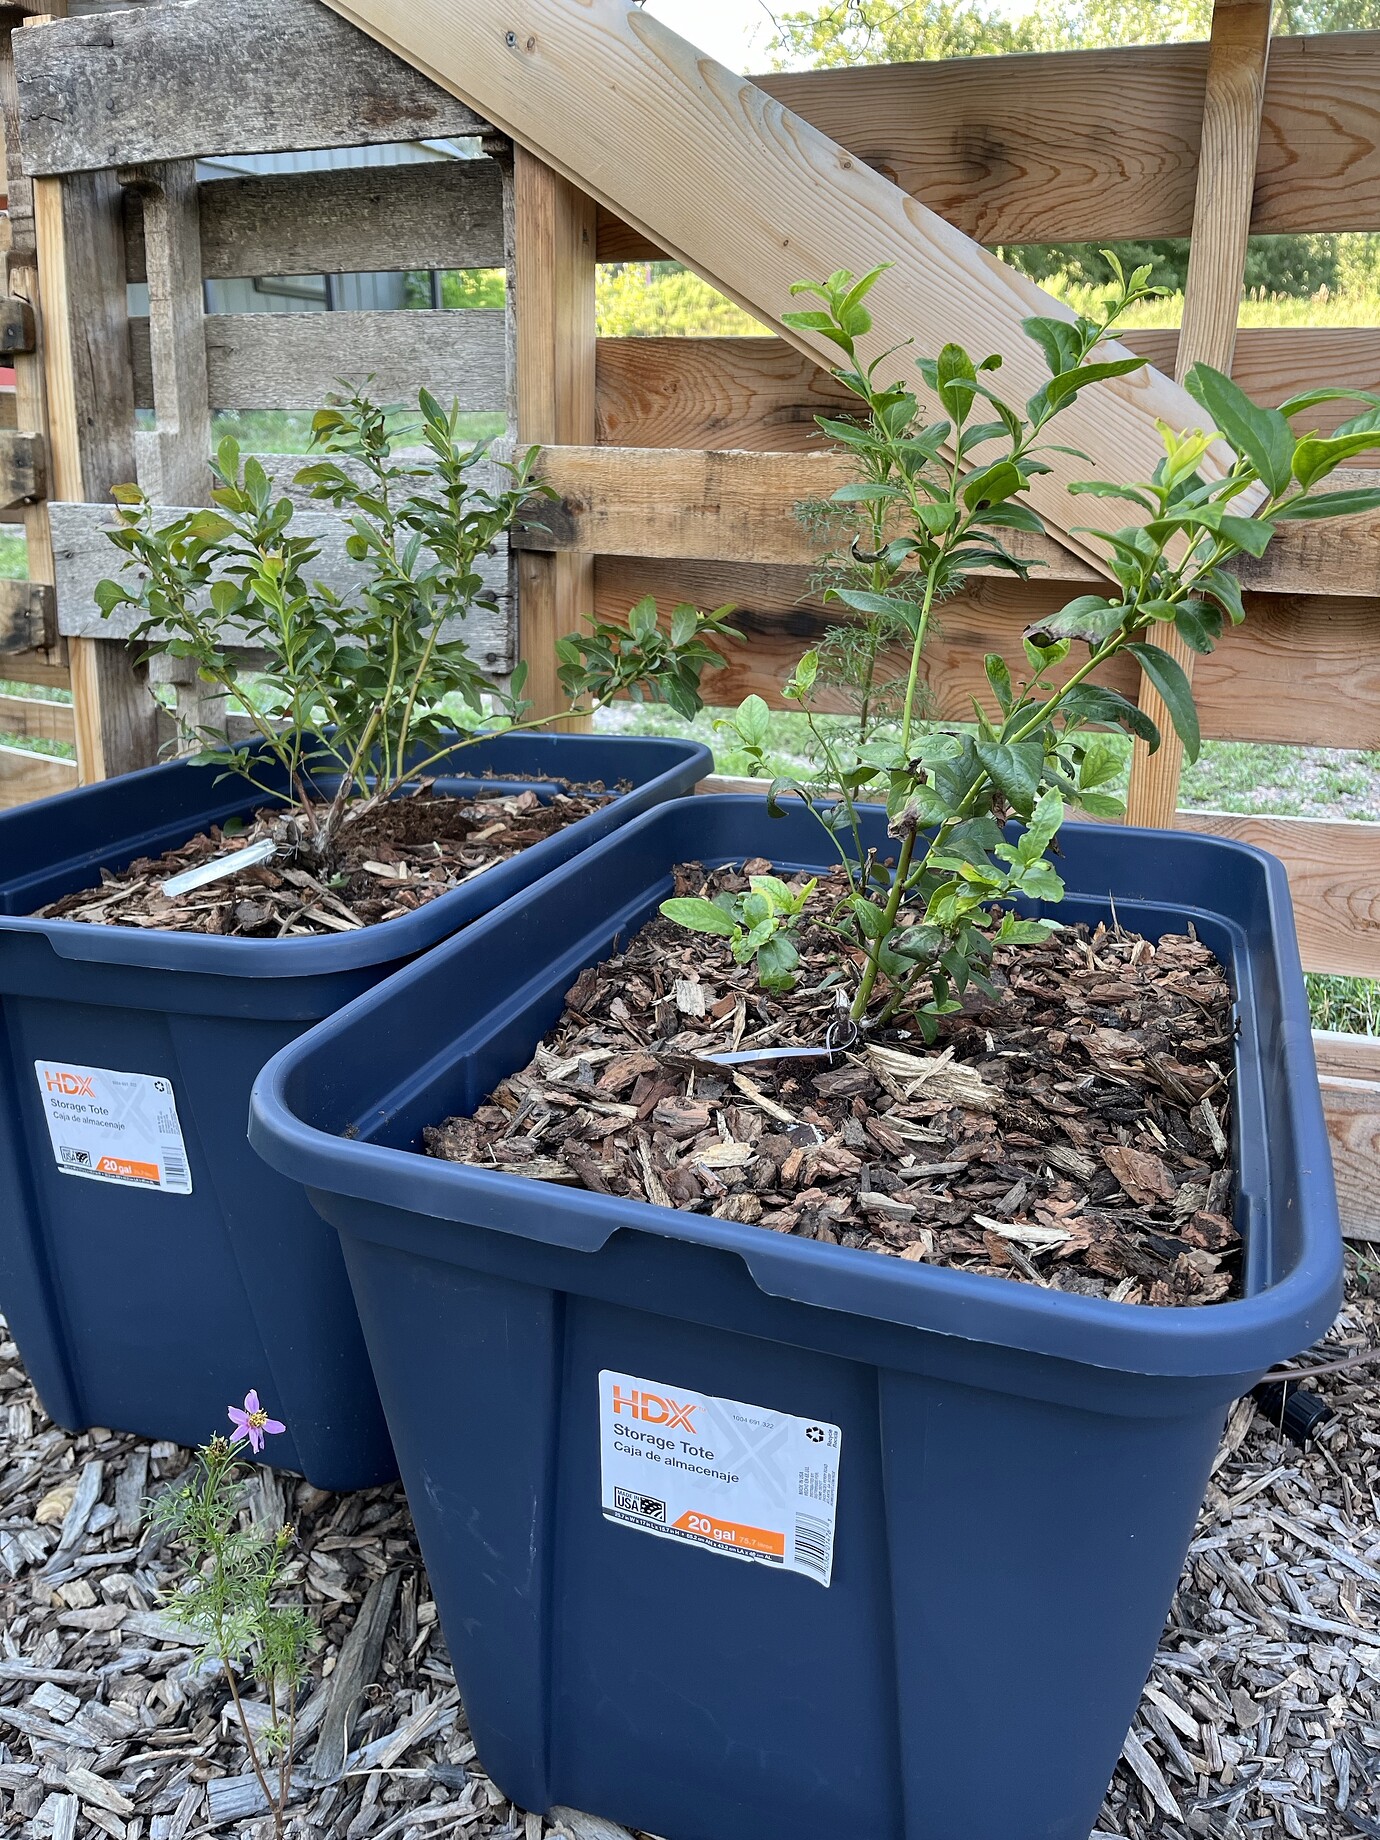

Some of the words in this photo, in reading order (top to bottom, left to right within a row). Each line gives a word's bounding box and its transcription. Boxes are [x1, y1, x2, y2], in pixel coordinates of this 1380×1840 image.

[45, 1071, 96, 1098] HDX
[51, 1098, 87, 1113] Storage
[88, 1104, 109, 1116] Tote
[53, 1111, 70, 1122] Caja
[71, 1114, 81, 1122] de
[82, 1117, 126, 1131] almacenaje
[103, 1159, 118, 1172] 20
[119, 1164, 132, 1175] gal
[613, 1385, 697, 1434] HDX
[732, 1415, 748, 1423] 1004
[613, 1423, 676, 1450] Storage
[680, 1440, 715, 1460] Tote
[613, 1441, 642, 1457] Caja
[645, 1450, 661, 1462] de
[664, 1457, 740, 1483] almacenaje
[617, 1489, 633, 1499] MADE
[617, 1495, 639, 1512] USA
[687, 1515, 712, 1534] 20
[713, 1528, 736, 1542] gal
[739, 1536, 757, 1545] 75.7
